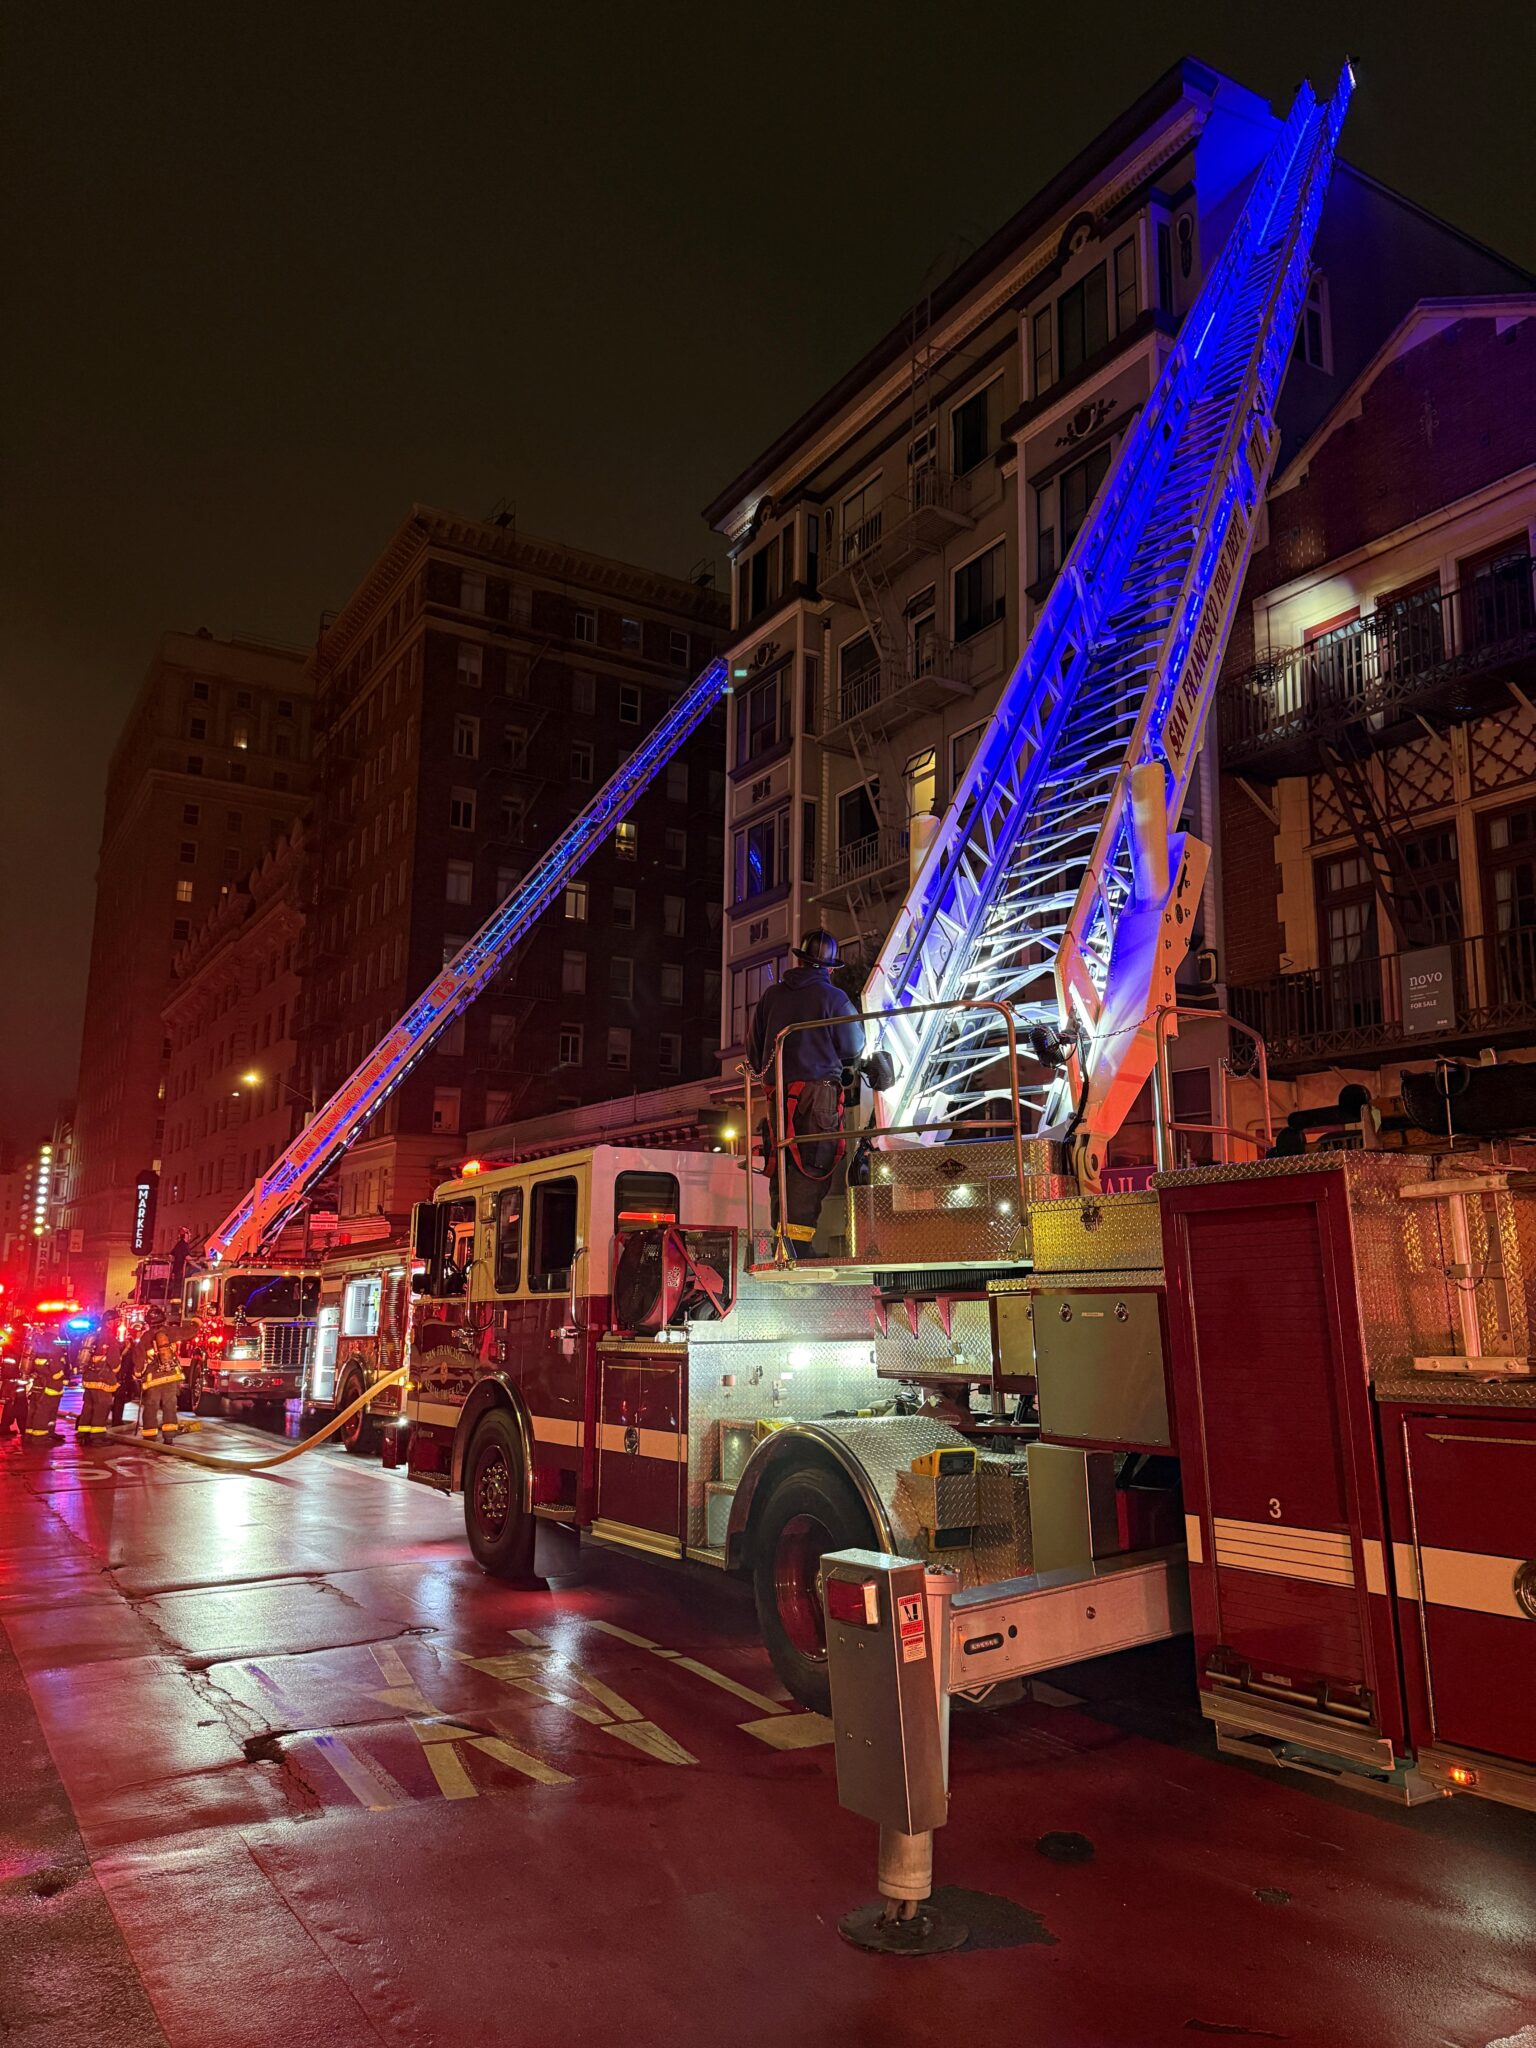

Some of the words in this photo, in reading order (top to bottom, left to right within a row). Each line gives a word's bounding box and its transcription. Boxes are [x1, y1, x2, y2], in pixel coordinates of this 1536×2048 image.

[1168, 703, 1189, 760] SAN
[1182, 599, 1220, 712] FRANCISCO
[1213, 556, 1233, 608] FIRE
[1409, 971, 1443, 987] novo
[1423, 999, 1437, 1007] SALE
[295, 1138, 316, 1161] SAN
[313, 1086, 362, 1139] FRANCISCO
[359, 1063, 383, 1087] FIRE
[135, 1189, 149, 1249] MARKER
[436, 1344, 466, 1365] FRANCISCO
[1268, 1497, 1282, 1519] 3
